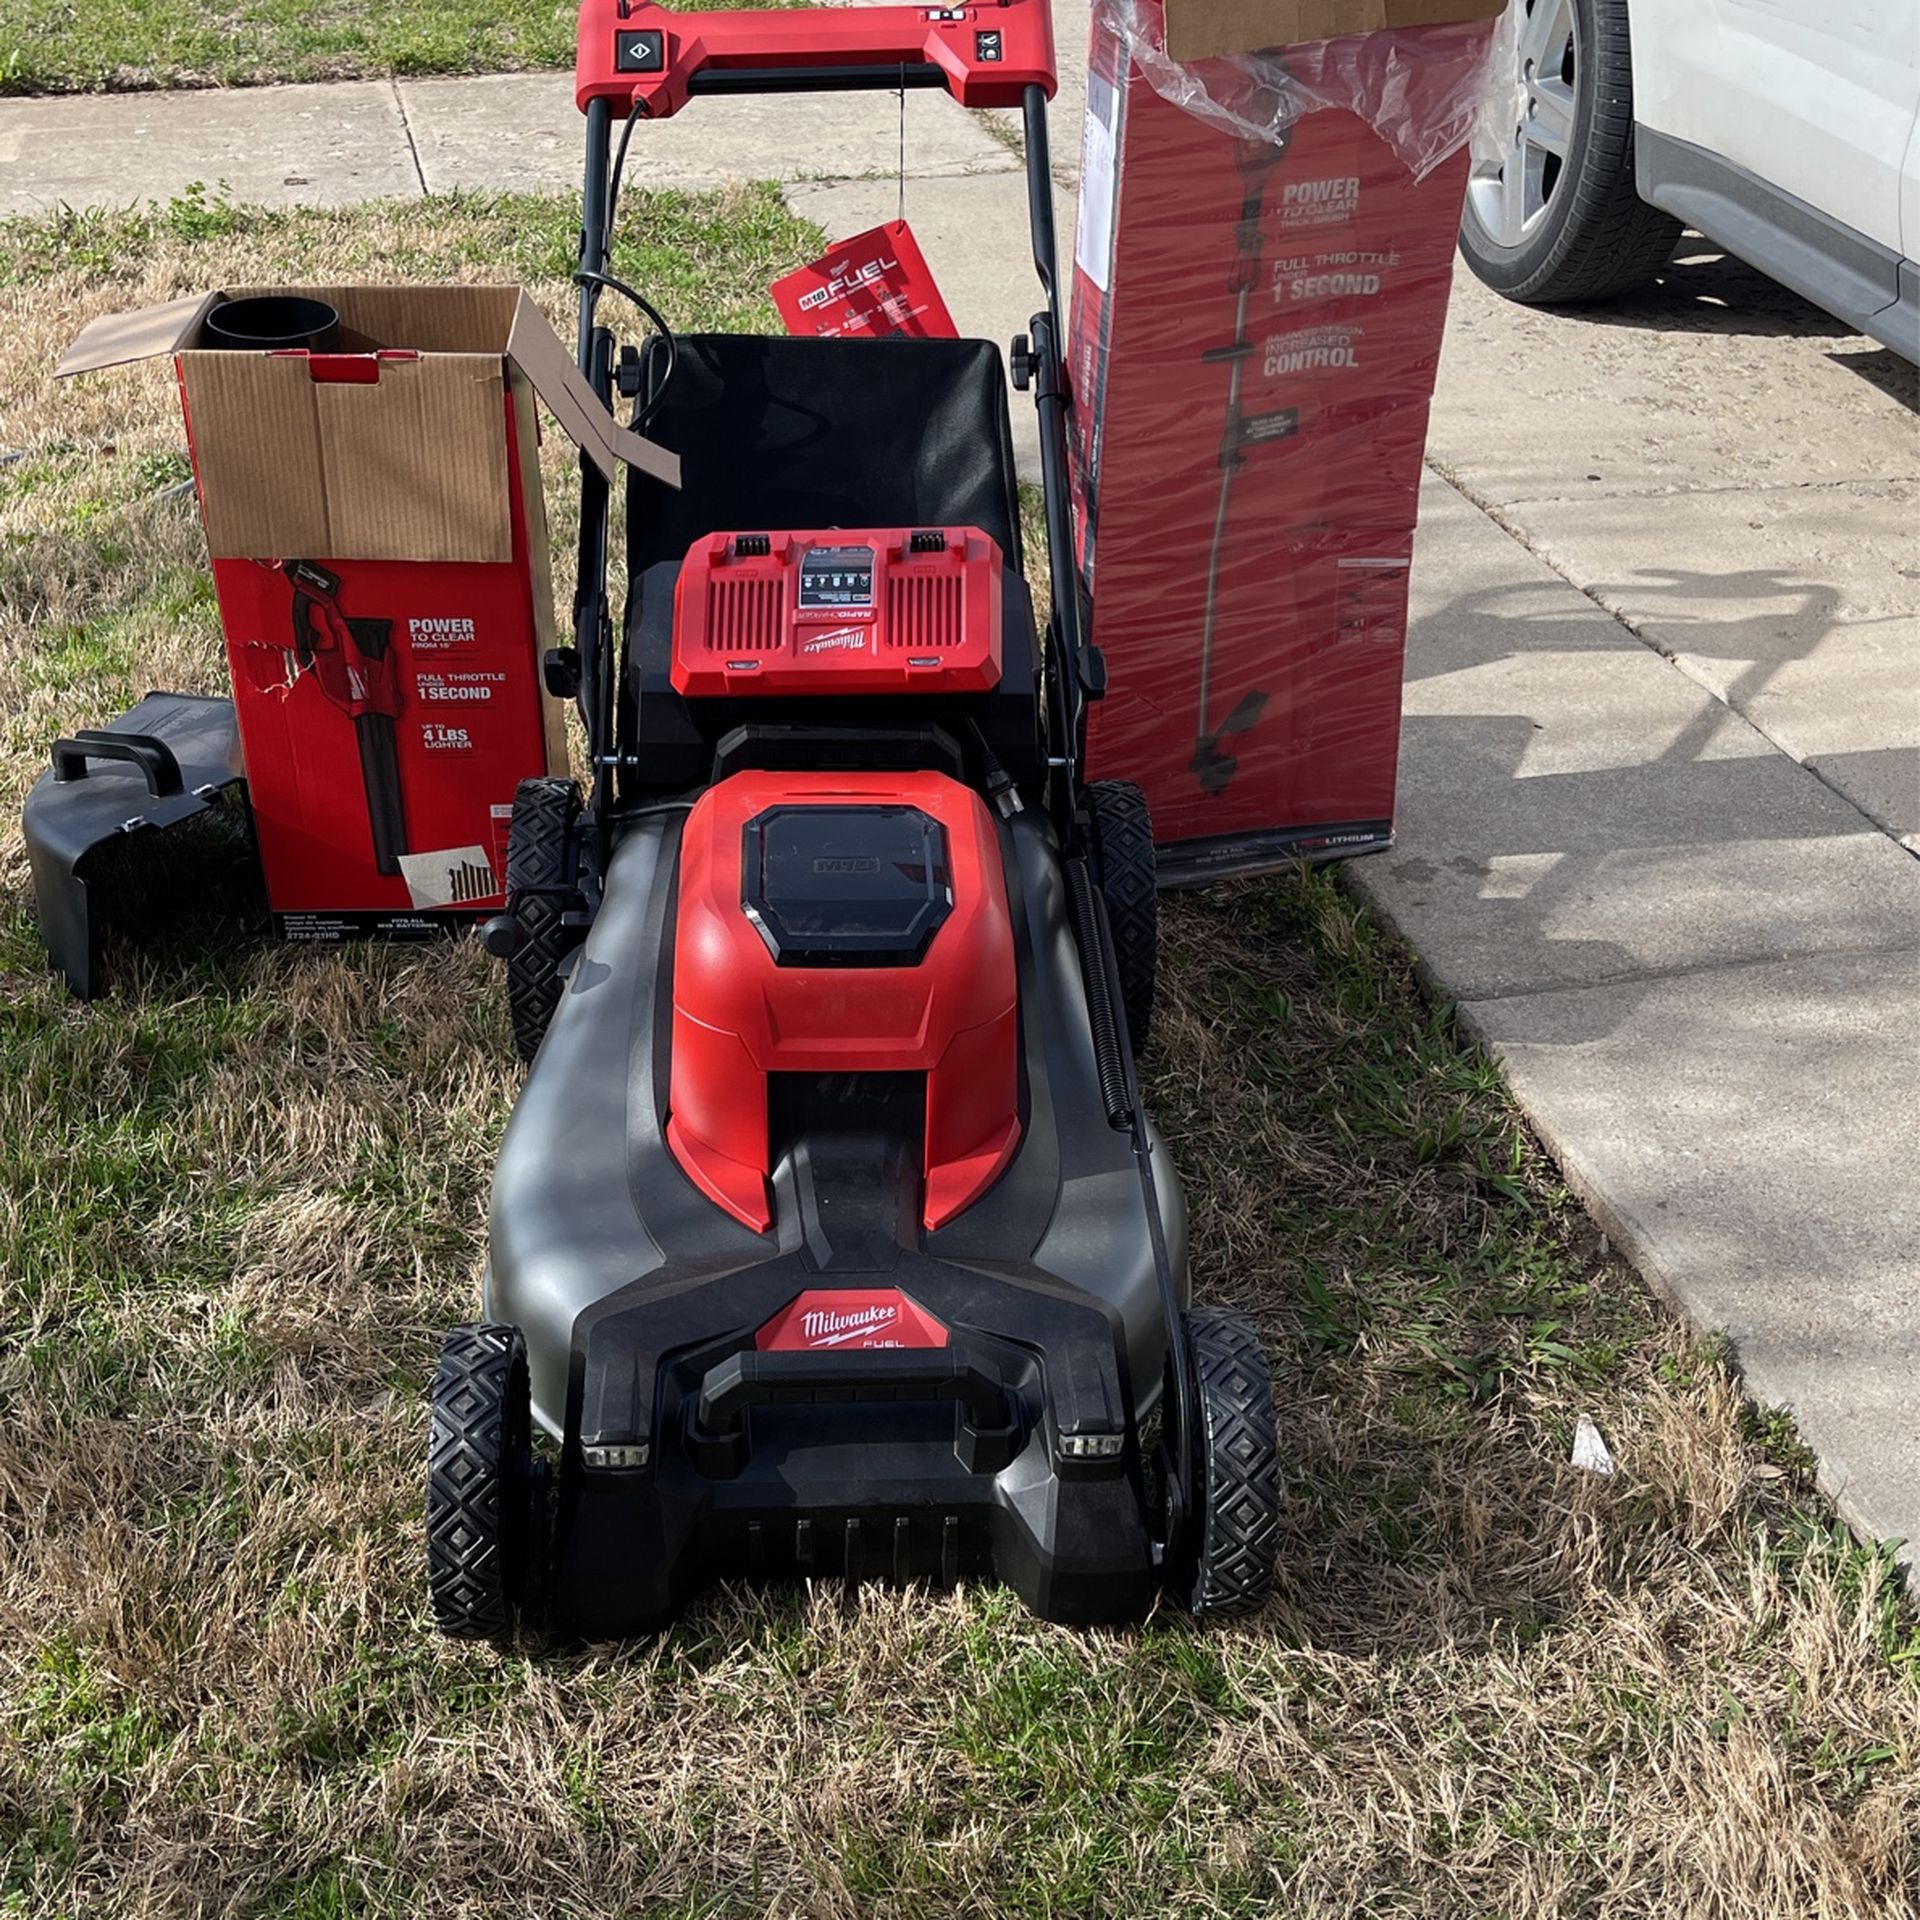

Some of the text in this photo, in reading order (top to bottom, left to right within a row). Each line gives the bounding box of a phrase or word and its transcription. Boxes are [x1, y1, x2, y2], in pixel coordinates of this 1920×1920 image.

[1282, 177, 1360, 205] POWER
[1305, 200, 1358, 217] CLEAR
[1273, 251, 1401, 273] FULL THROTTLE
[800, 289, 827, 310] M18
[828, 257, 897, 296] FUEL
[1272, 275, 1380, 303] 1 SECOND
[1265, 335, 1351, 356] INCREASED
[1264, 348, 1359, 377] CONTROL
[408, 618, 475, 633] POWER
[411, 633, 475, 642] TO CLEAR
[804, 631, 866, 653] Milwaukee
[448, 673, 506, 681] THROTTLE
[429, 687, 491, 700] SECOND
[423, 729, 468, 741] 4 LBS
[424, 741, 472, 749] LIGHTER
[800, 1305, 897, 1338] Milwaukee
[863, 1340, 905, 1348] FUEL
